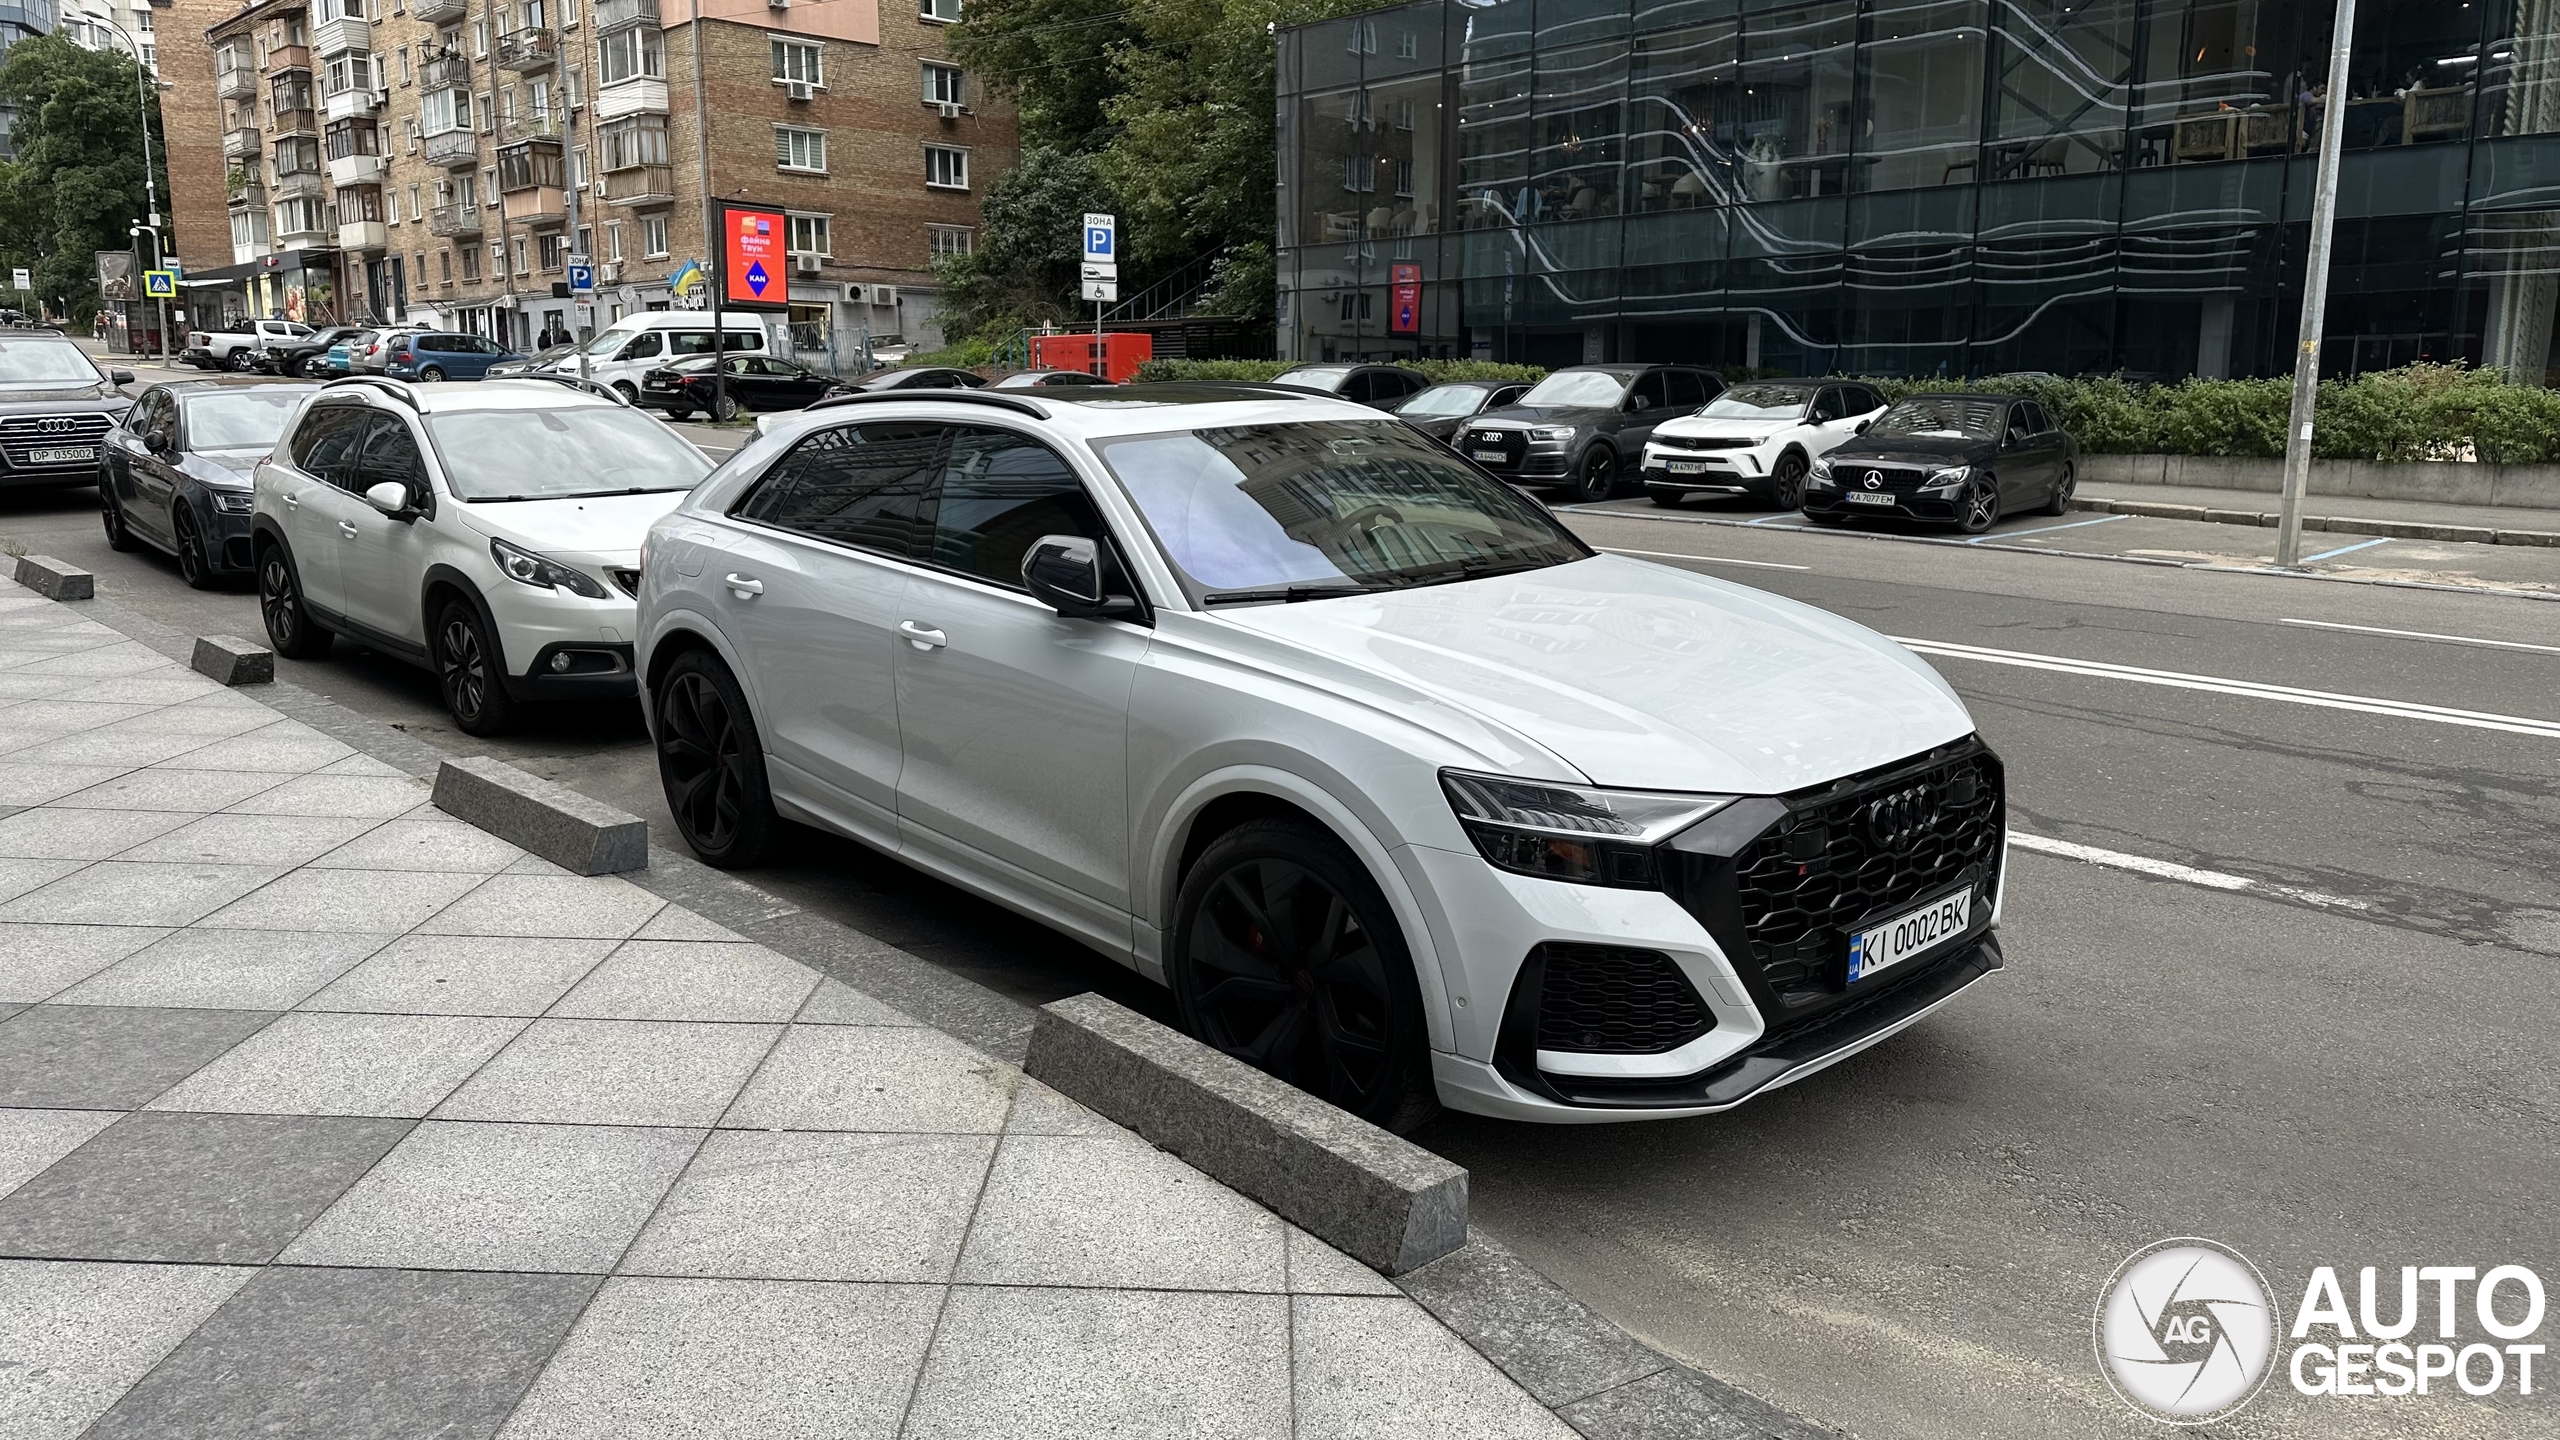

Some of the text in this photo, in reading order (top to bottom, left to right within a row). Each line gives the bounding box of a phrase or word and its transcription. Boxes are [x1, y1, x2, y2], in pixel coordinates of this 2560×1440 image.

[1087, 216, 1112, 226] ЗОНА
[1092, 229, 1107, 252] P
[570, 257, 589, 265] ЗОНА
[572, 268, 589, 287] P
[749, 274, 766, 283] KAN
[33, 449, 92, 461] DP 035002
[1670, 462, 1679, 470] KA
[1850, 493, 1893, 504] KA 7077 EM
[1861, 895, 1967, 971] KI 0002 BK
[1849, 963, 1859, 975] UA
